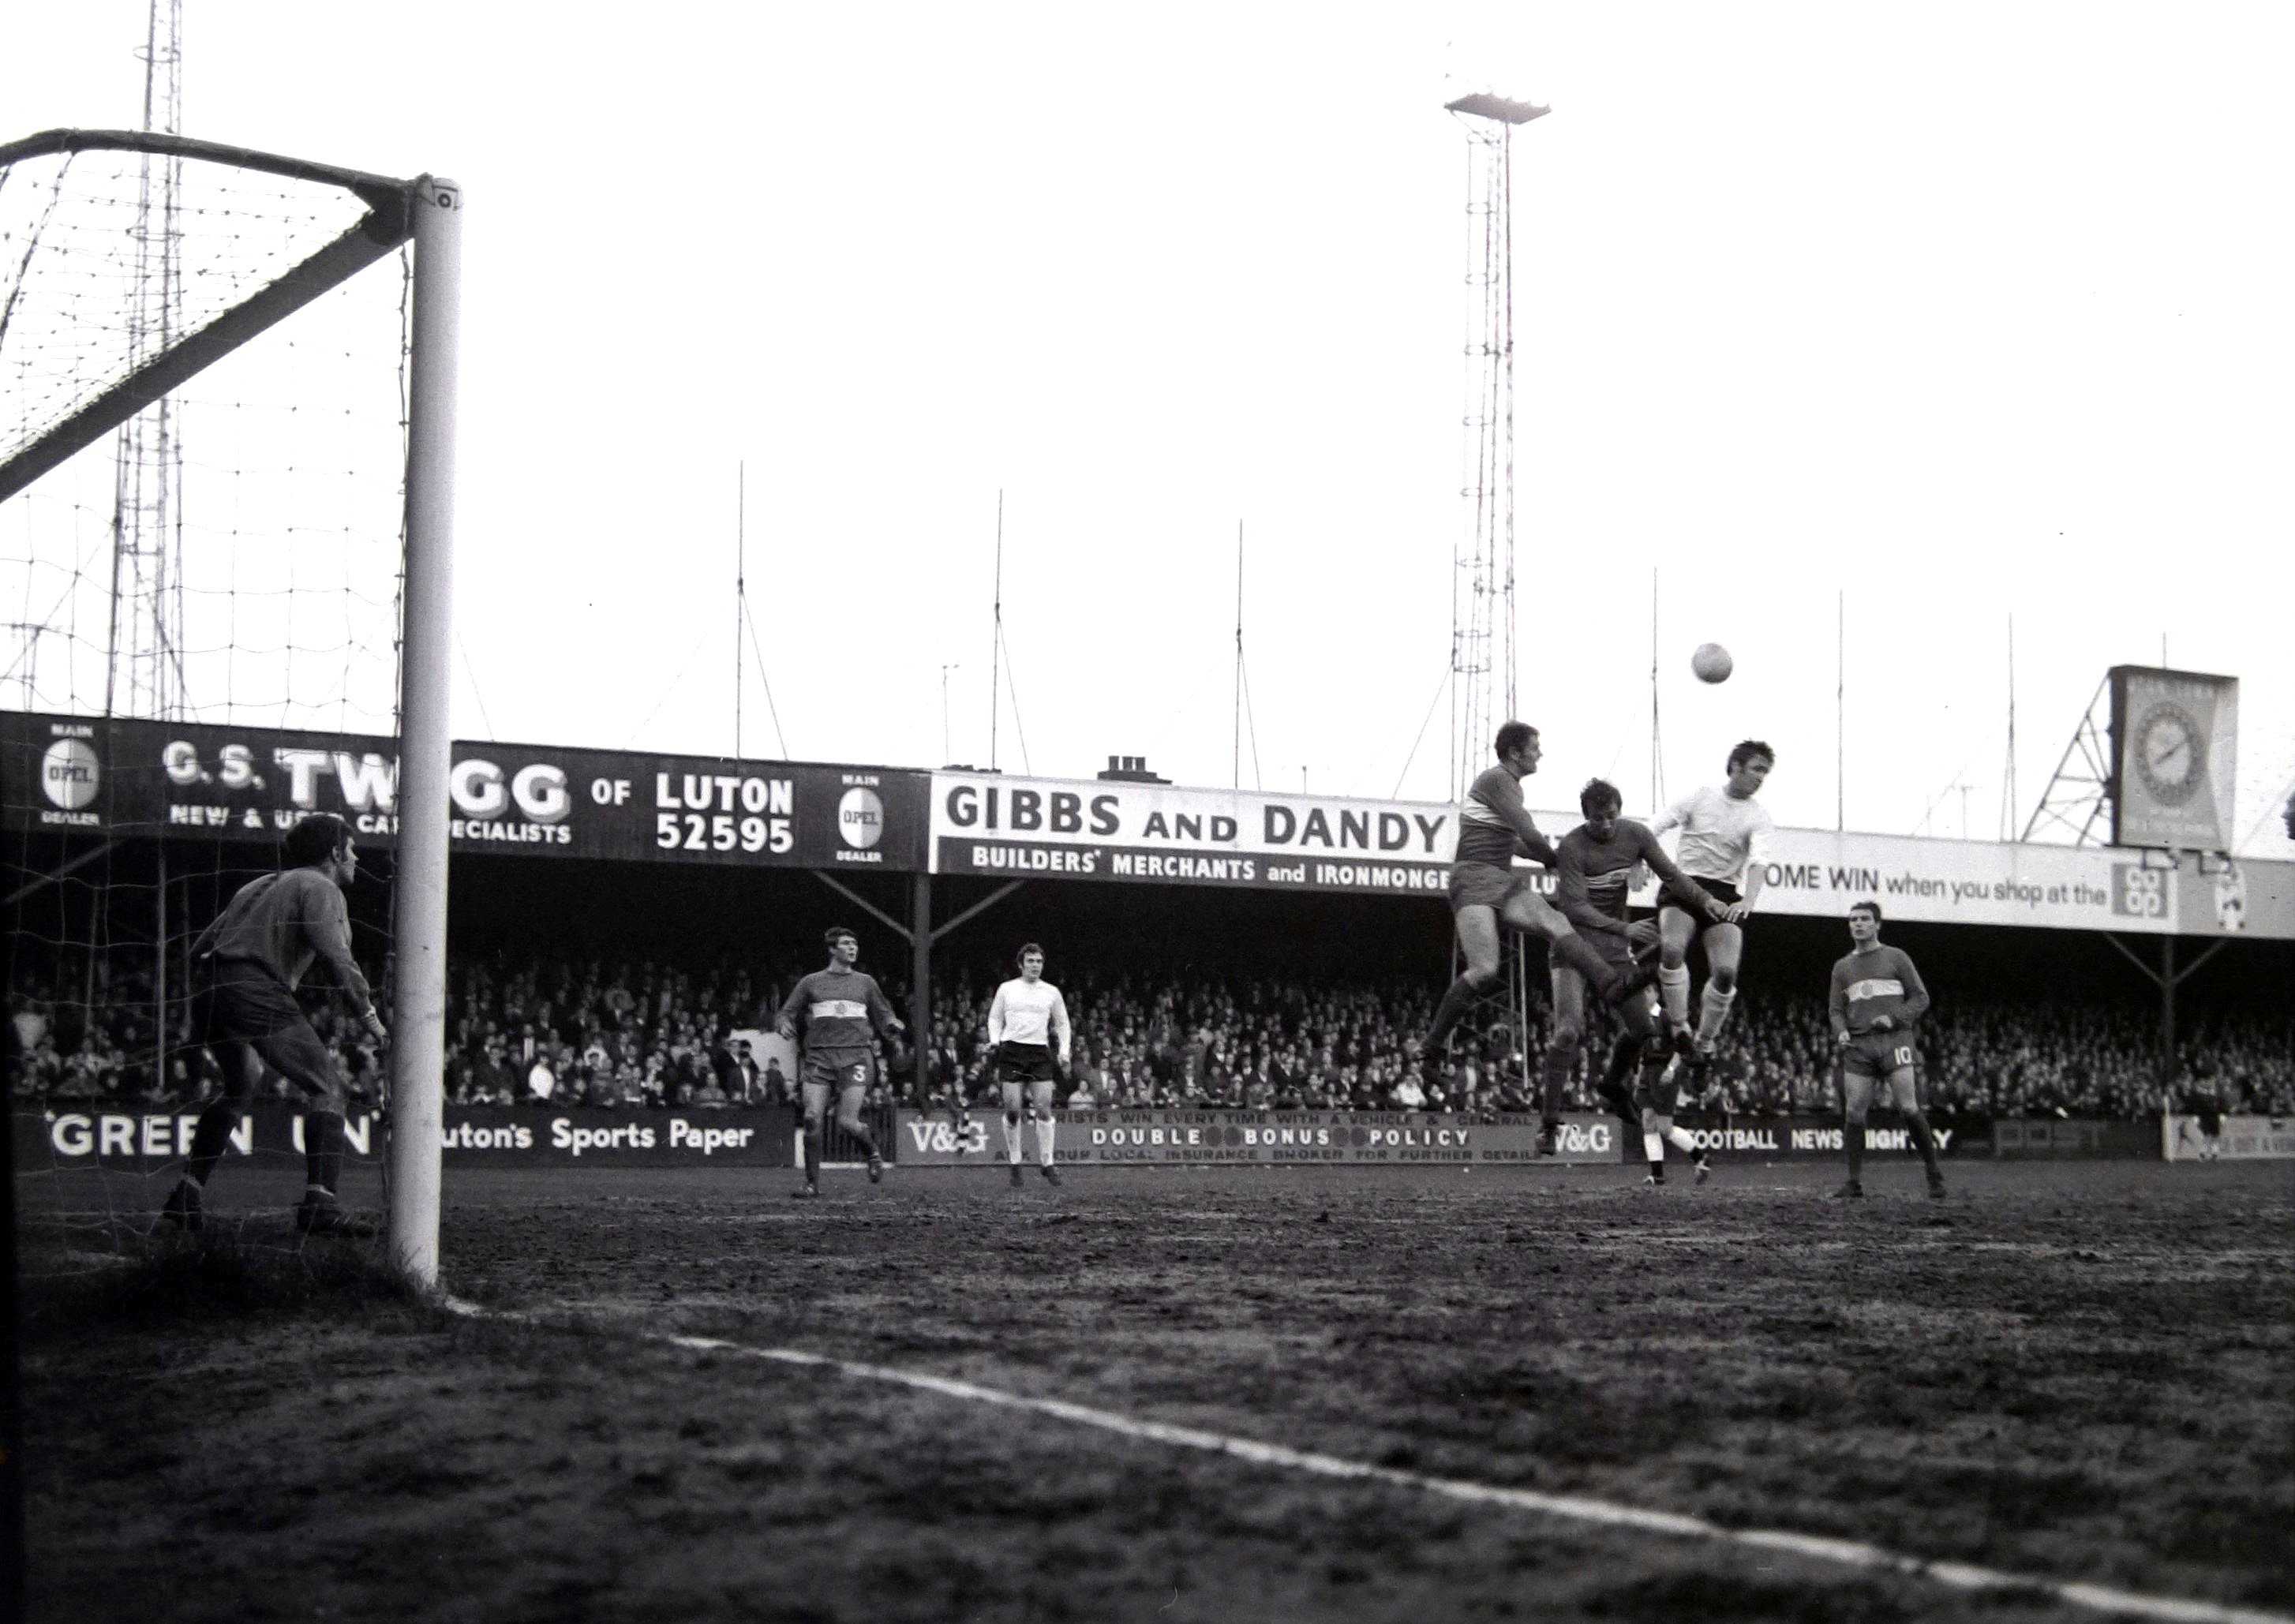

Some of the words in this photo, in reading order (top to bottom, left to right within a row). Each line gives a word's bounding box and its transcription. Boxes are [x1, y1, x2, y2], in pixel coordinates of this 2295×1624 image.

[49, 766, 92, 783] OPEL
[274, 747, 571, 822] TWGG
[591, 778, 631, 805] OF
[841, 775, 880, 787] MAIN
[656, 773, 793, 815] LUTON
[170, 805, 229, 826] NEW
[243, 808, 264, 829] &
[451, 819, 571, 844] ECIALISTS
[844, 810, 878, 825] OPEL
[947, 785, 1120, 836] GIBBS
[1143, 811, 1237, 843] AND
[1264, 805, 1448, 853] DANDY
[656, 814, 793, 854] 52595
[836, 850, 883, 863] DEALER
[972, 847, 1101, 873] BUILDERS'
[1114, 853, 1255, 881] MERCHANTS
[1267, 863, 1305, 883] and
[1316, 864, 1451, 890] IRONMONGE
[1764, 863, 1821, 889] OME
[1828, 866, 1880, 892] WIN
[1885, 870, 1945, 897] when
[1951, 881, 1988, 905] you
[1994, 877, 2043, 909] shop
[2047, 884, 2068, 905] at
[2073, 883, 2107, 906] the
[1894, 1046, 1913, 1066] 10
[853, 1065, 866, 1082] 3
[1121, 1113, 1152, 1124] WIN
[1163, 1113, 1217, 1124] EVERY
[1224, 1113, 1266, 1124] TIME
[1276, 1113, 1320, 1124] WITH
[1330, 1113, 1340, 1124] A
[1350, 1113, 1413, 1125] VEHICLE
[441, 1122, 534, 1149] uton's
[551, 1117, 655, 1156] Sports
[669, 1117, 754, 1155] Paper
[908, 1121, 990, 1154] V&G
[1091, 1128, 1201, 1146] DOUBLE
[1244, 1128, 1330, 1146] BONUS
[1369, 1128, 1468, 1146] POLICY
[1555, 1124, 1612, 1153] V&G
[1791, 1128, 1844, 1150] NEWS
[1054, 1150, 1091, 1161] OUR
[1166, 1149, 1259, 1161] INSURANCE
[1355, 1150, 1388, 1160] FOR
[1399, 1150, 1473, 1161] FURTHER
